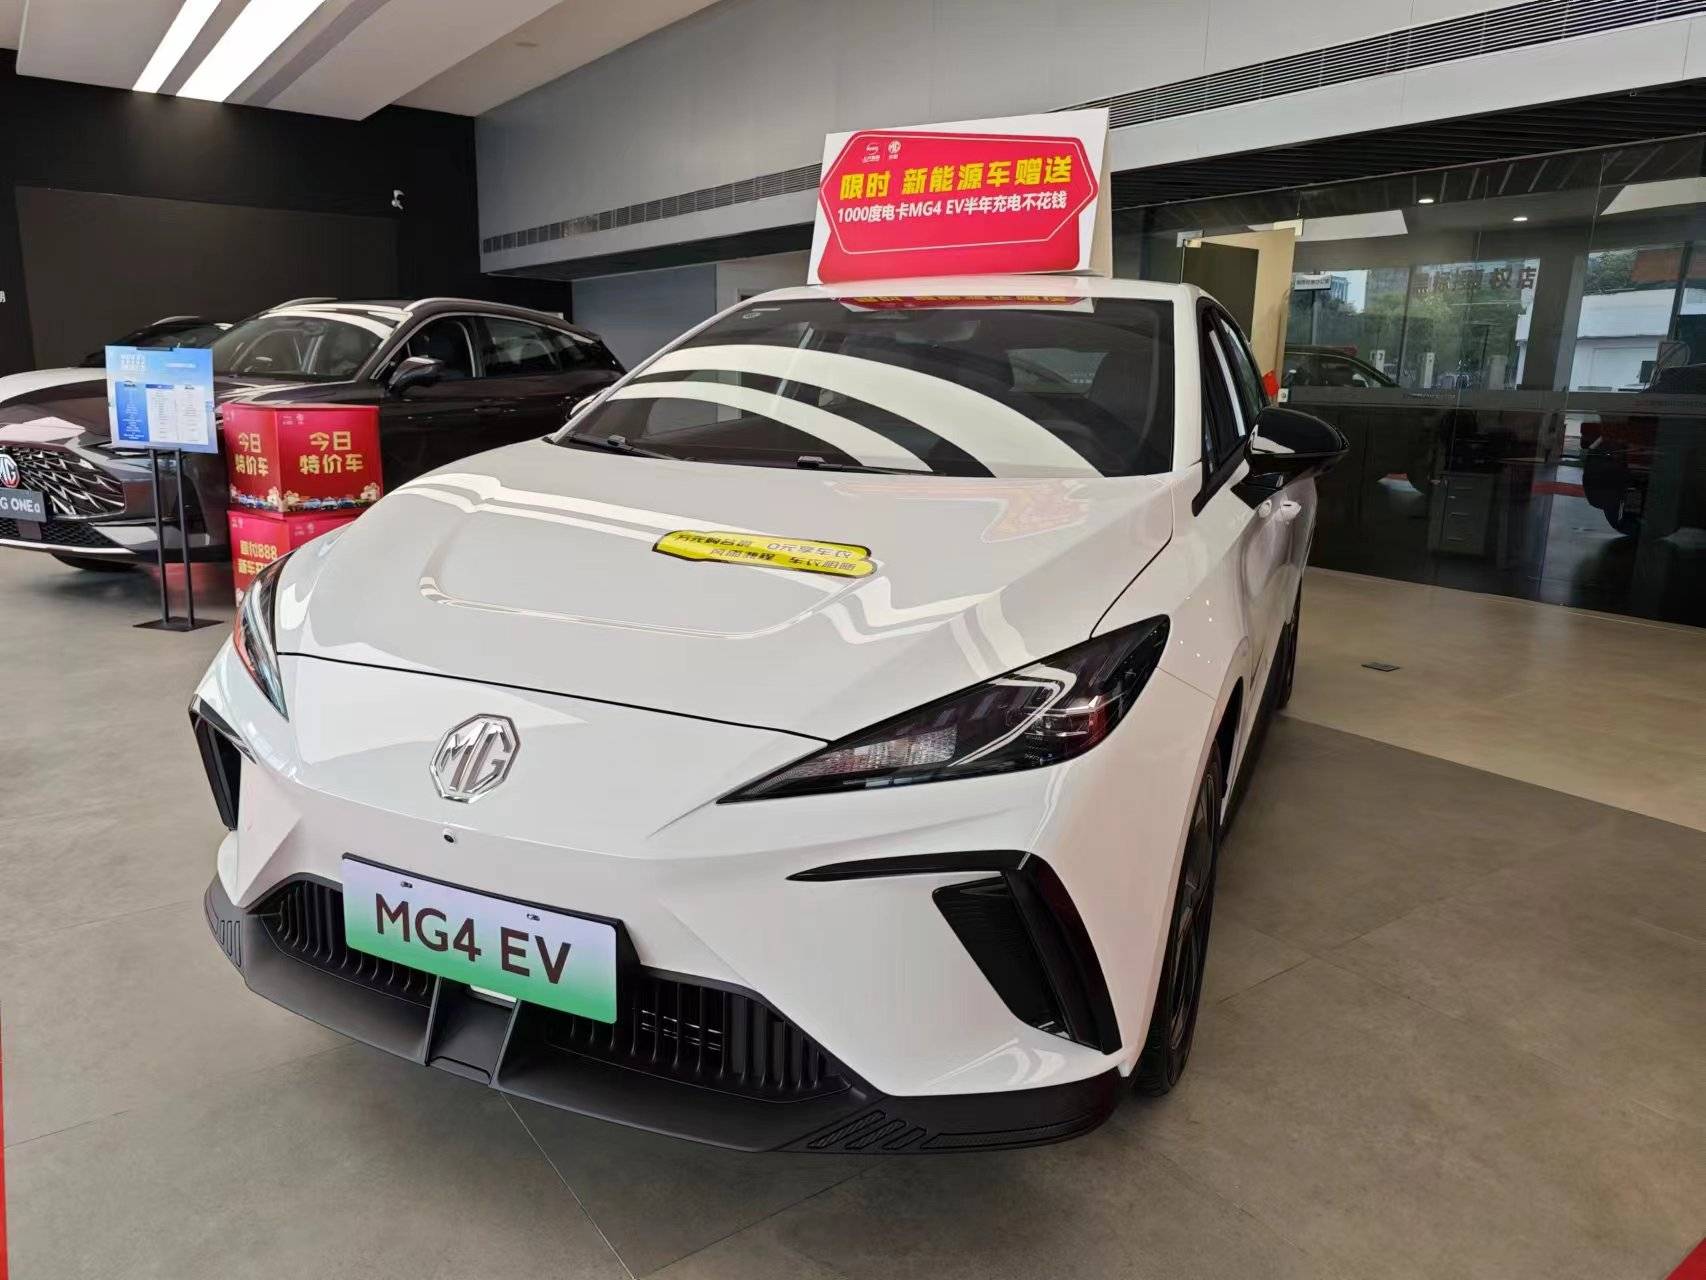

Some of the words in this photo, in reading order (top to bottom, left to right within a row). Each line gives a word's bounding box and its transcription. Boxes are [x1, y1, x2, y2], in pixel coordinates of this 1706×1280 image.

[839, 170, 892, 201] 限时
[901, 154, 1073, 195] 新能源车赠送
[836, 200, 942, 224] 1000度电卡MG4
[945, 190, 1068, 216] EV半年充电不花钱
[238, 432, 262, 453] 今日
[310, 431, 351, 451] 今日
[235, 454, 269, 477] 特价车
[300, 453, 364, 475] 特价车
[435, 717, 515, 798] MG
[376, 893, 482, 962] MG4
[501, 927, 571, 985] EV
